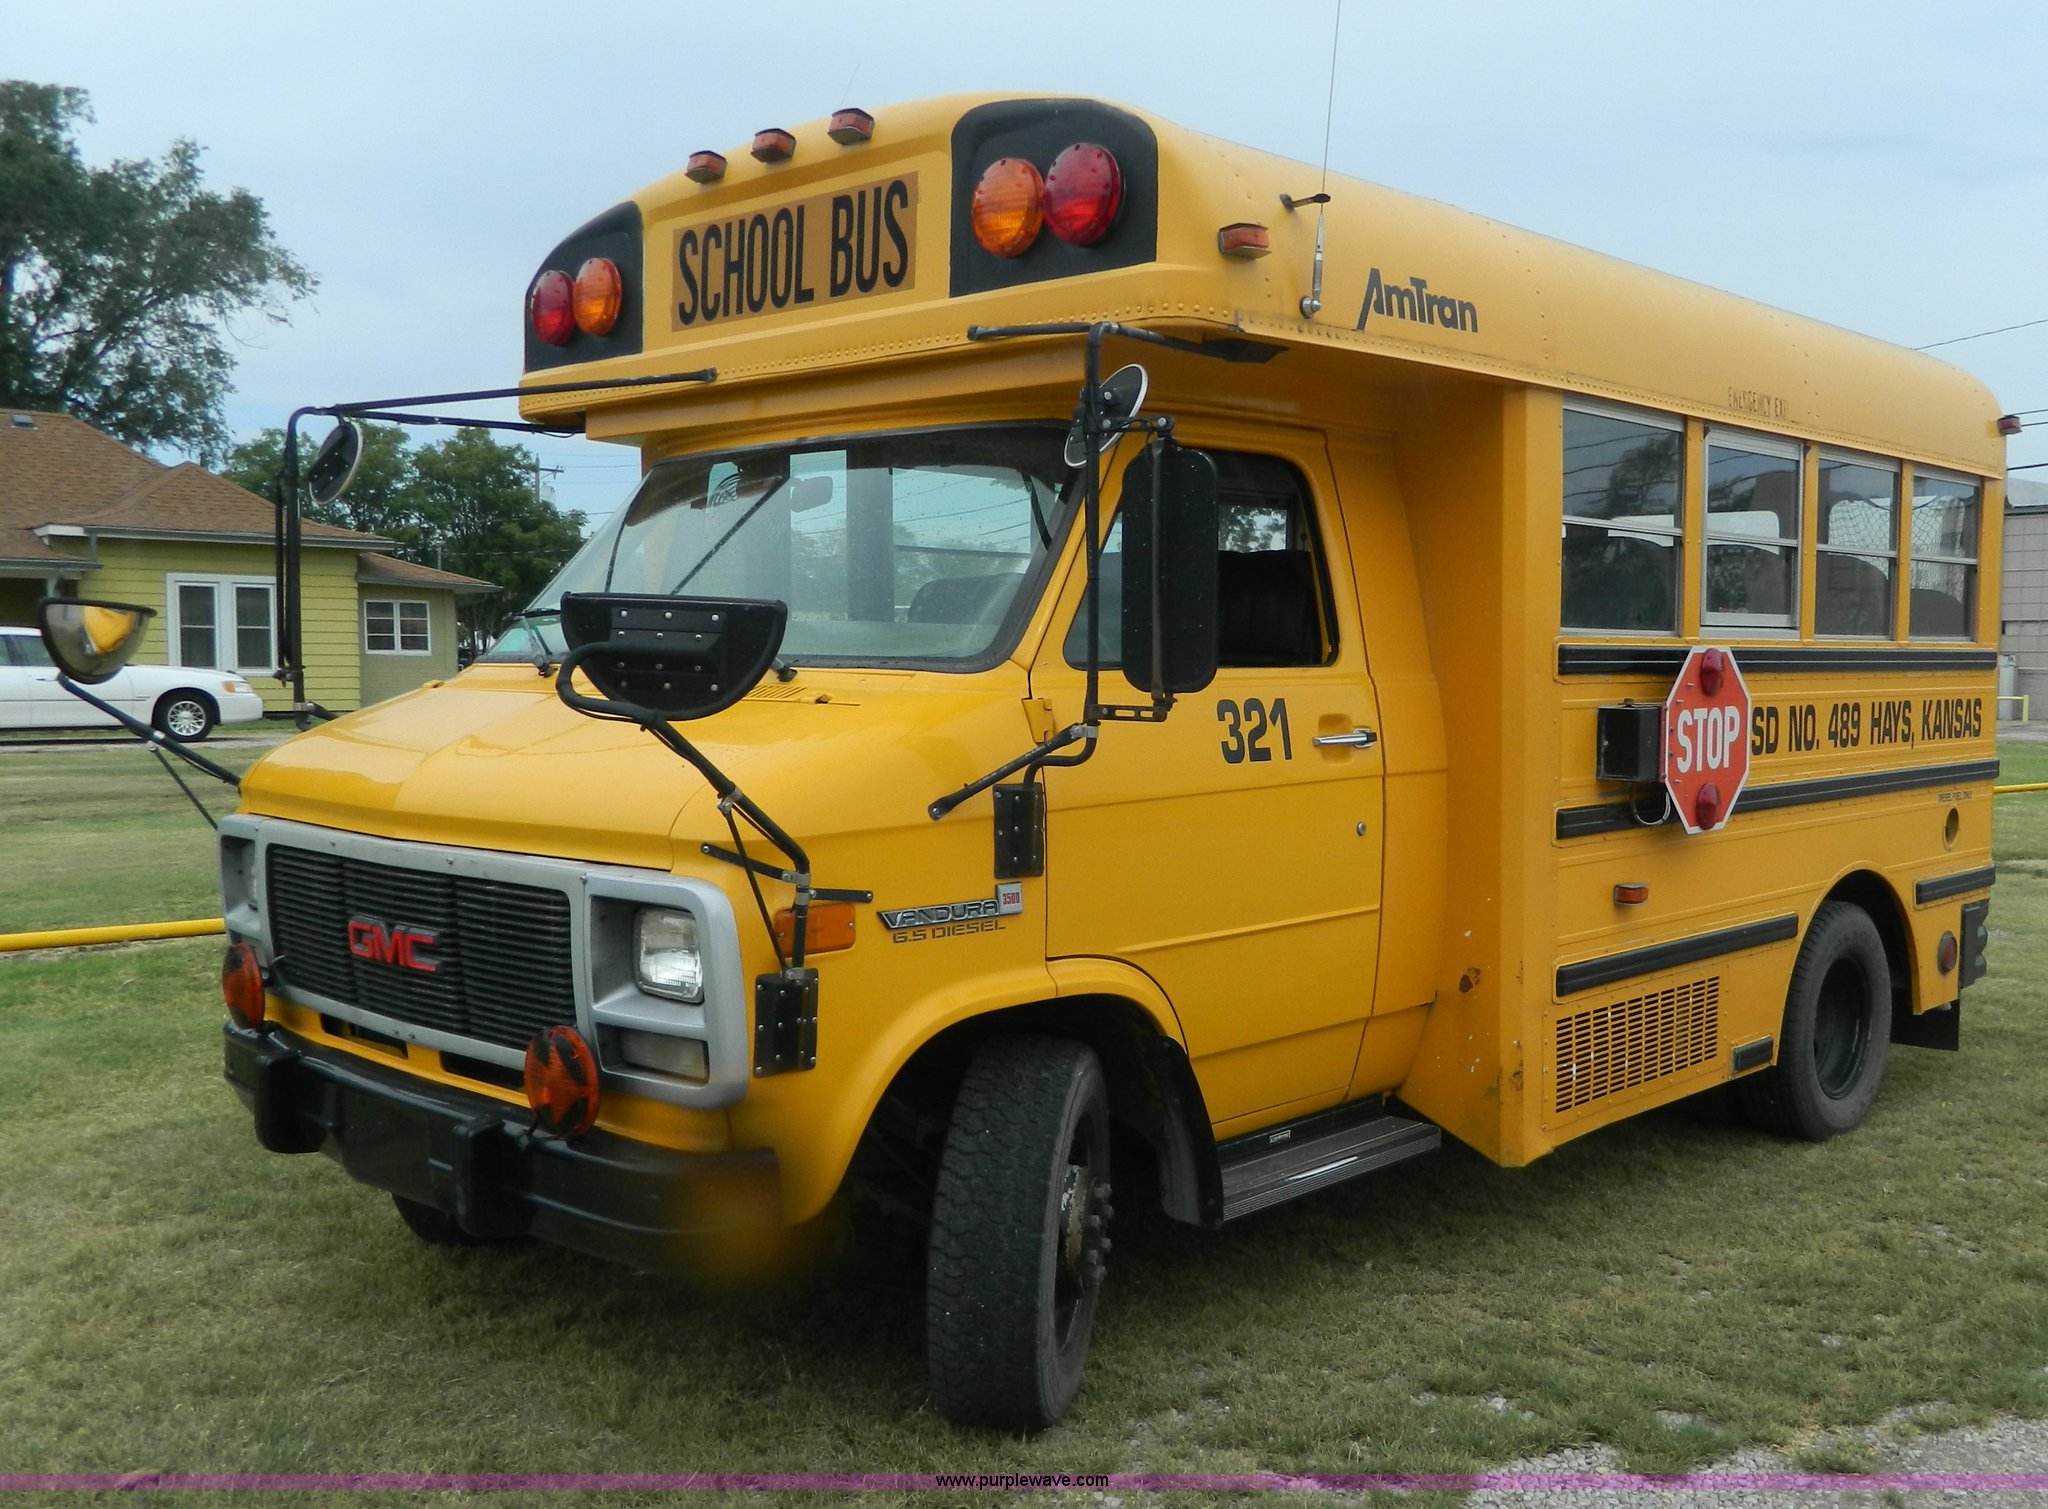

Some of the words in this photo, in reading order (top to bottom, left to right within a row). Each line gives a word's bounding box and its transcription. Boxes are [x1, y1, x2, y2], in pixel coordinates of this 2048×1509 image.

[678, 205, 815, 326] SCHOOL
[829, 179, 909, 298] BUS
[1356, 267, 1479, 334] AmTran
[1216, 697, 1293, 765] 321
[1676, 705, 1740, 774] STOP
[1751, 706, 1779, 756] SD
[1788, 703, 1820, 753] NO.
[1828, 702, 1861, 749] 489
[1870, 699, 1915, 750] HAYS,
[1921, 697, 1982, 741] KANSAS
[880, 899, 1000, 929] VANDURA
[1002, 891, 1021, 905] 3500
[347, 915, 440, 972] GMC
[893, 929, 927, 944] 6.5
[931, 920, 1006, 939] DIESEL
